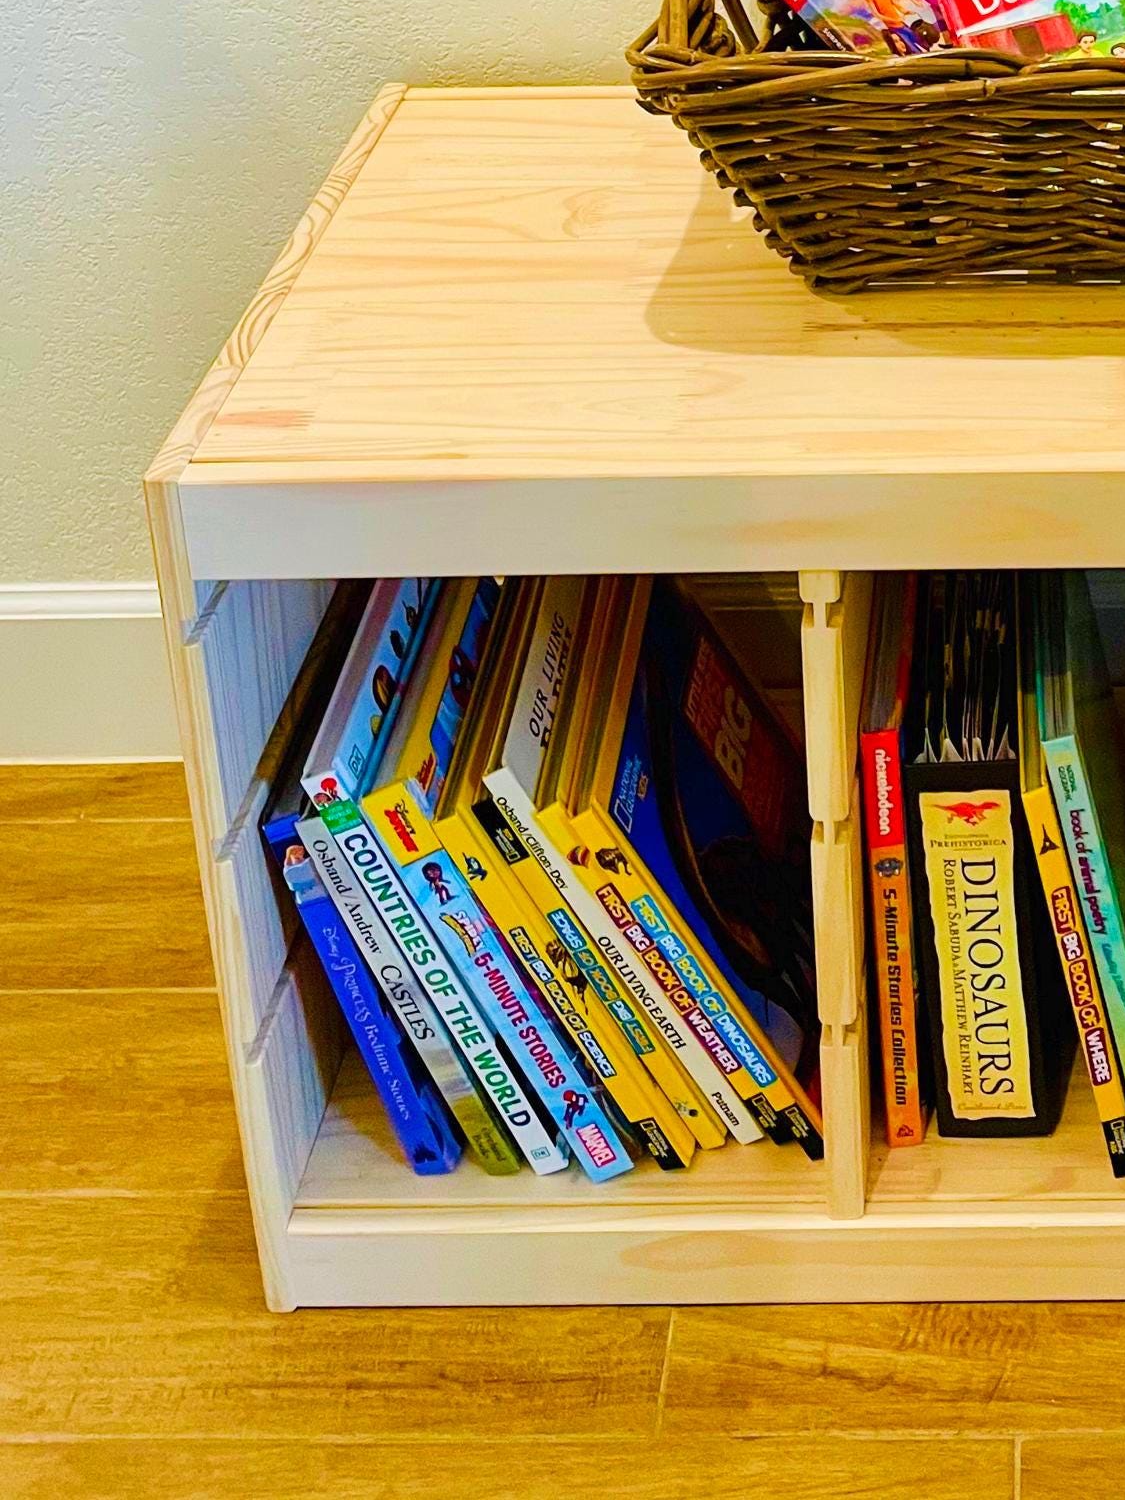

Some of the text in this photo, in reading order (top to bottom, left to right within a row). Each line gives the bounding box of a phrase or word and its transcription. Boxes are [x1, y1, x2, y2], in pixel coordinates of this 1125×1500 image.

[529, 612, 566, 738] OUR LIVING
[875, 749, 894, 835] nickelodeon
[930, 839, 1007, 848] PREHISTORICA
[344, 833, 436, 966] COUNTRIES
[425, 969, 455, 998] OF
[445, 1001, 481, 1048] THE
[474, 1050, 531, 1127] WORLD
[345, 901, 381, 956] Andrew
[381, 964, 435, 1040] CASTLES
[474, 952, 566, 1088] 5-MINUTE STORIES
[510, 928, 616, 1077] FIRST BIG BOOK OF SCIENCE
[597, 885, 740, 1074] FIRST BIG BOOK OF WEATHER
[598, 936, 686, 1049] OUR LIVING EARTH
[632, 896, 667, 940] FIRST
[659, 933, 685, 959] BIG
[675, 955, 710, 997] BOOK
[702, 993, 725, 1015] OF
[716, 1013, 775, 1087] DINOSAURS
[883, 888, 907, 1105] 5-Minute Stories Collection
[943, 859, 974, 1096] ROBERT SABUDA MATTHEW REINHART
[960, 857, 1015, 1096] DINOSAURS
[1053, 888, 1110, 1084] FIRST BIG BOOK OF WHERE
[577, 1124, 614, 1168] MARVEL
[711, 1091, 739, 1127] Putnam
